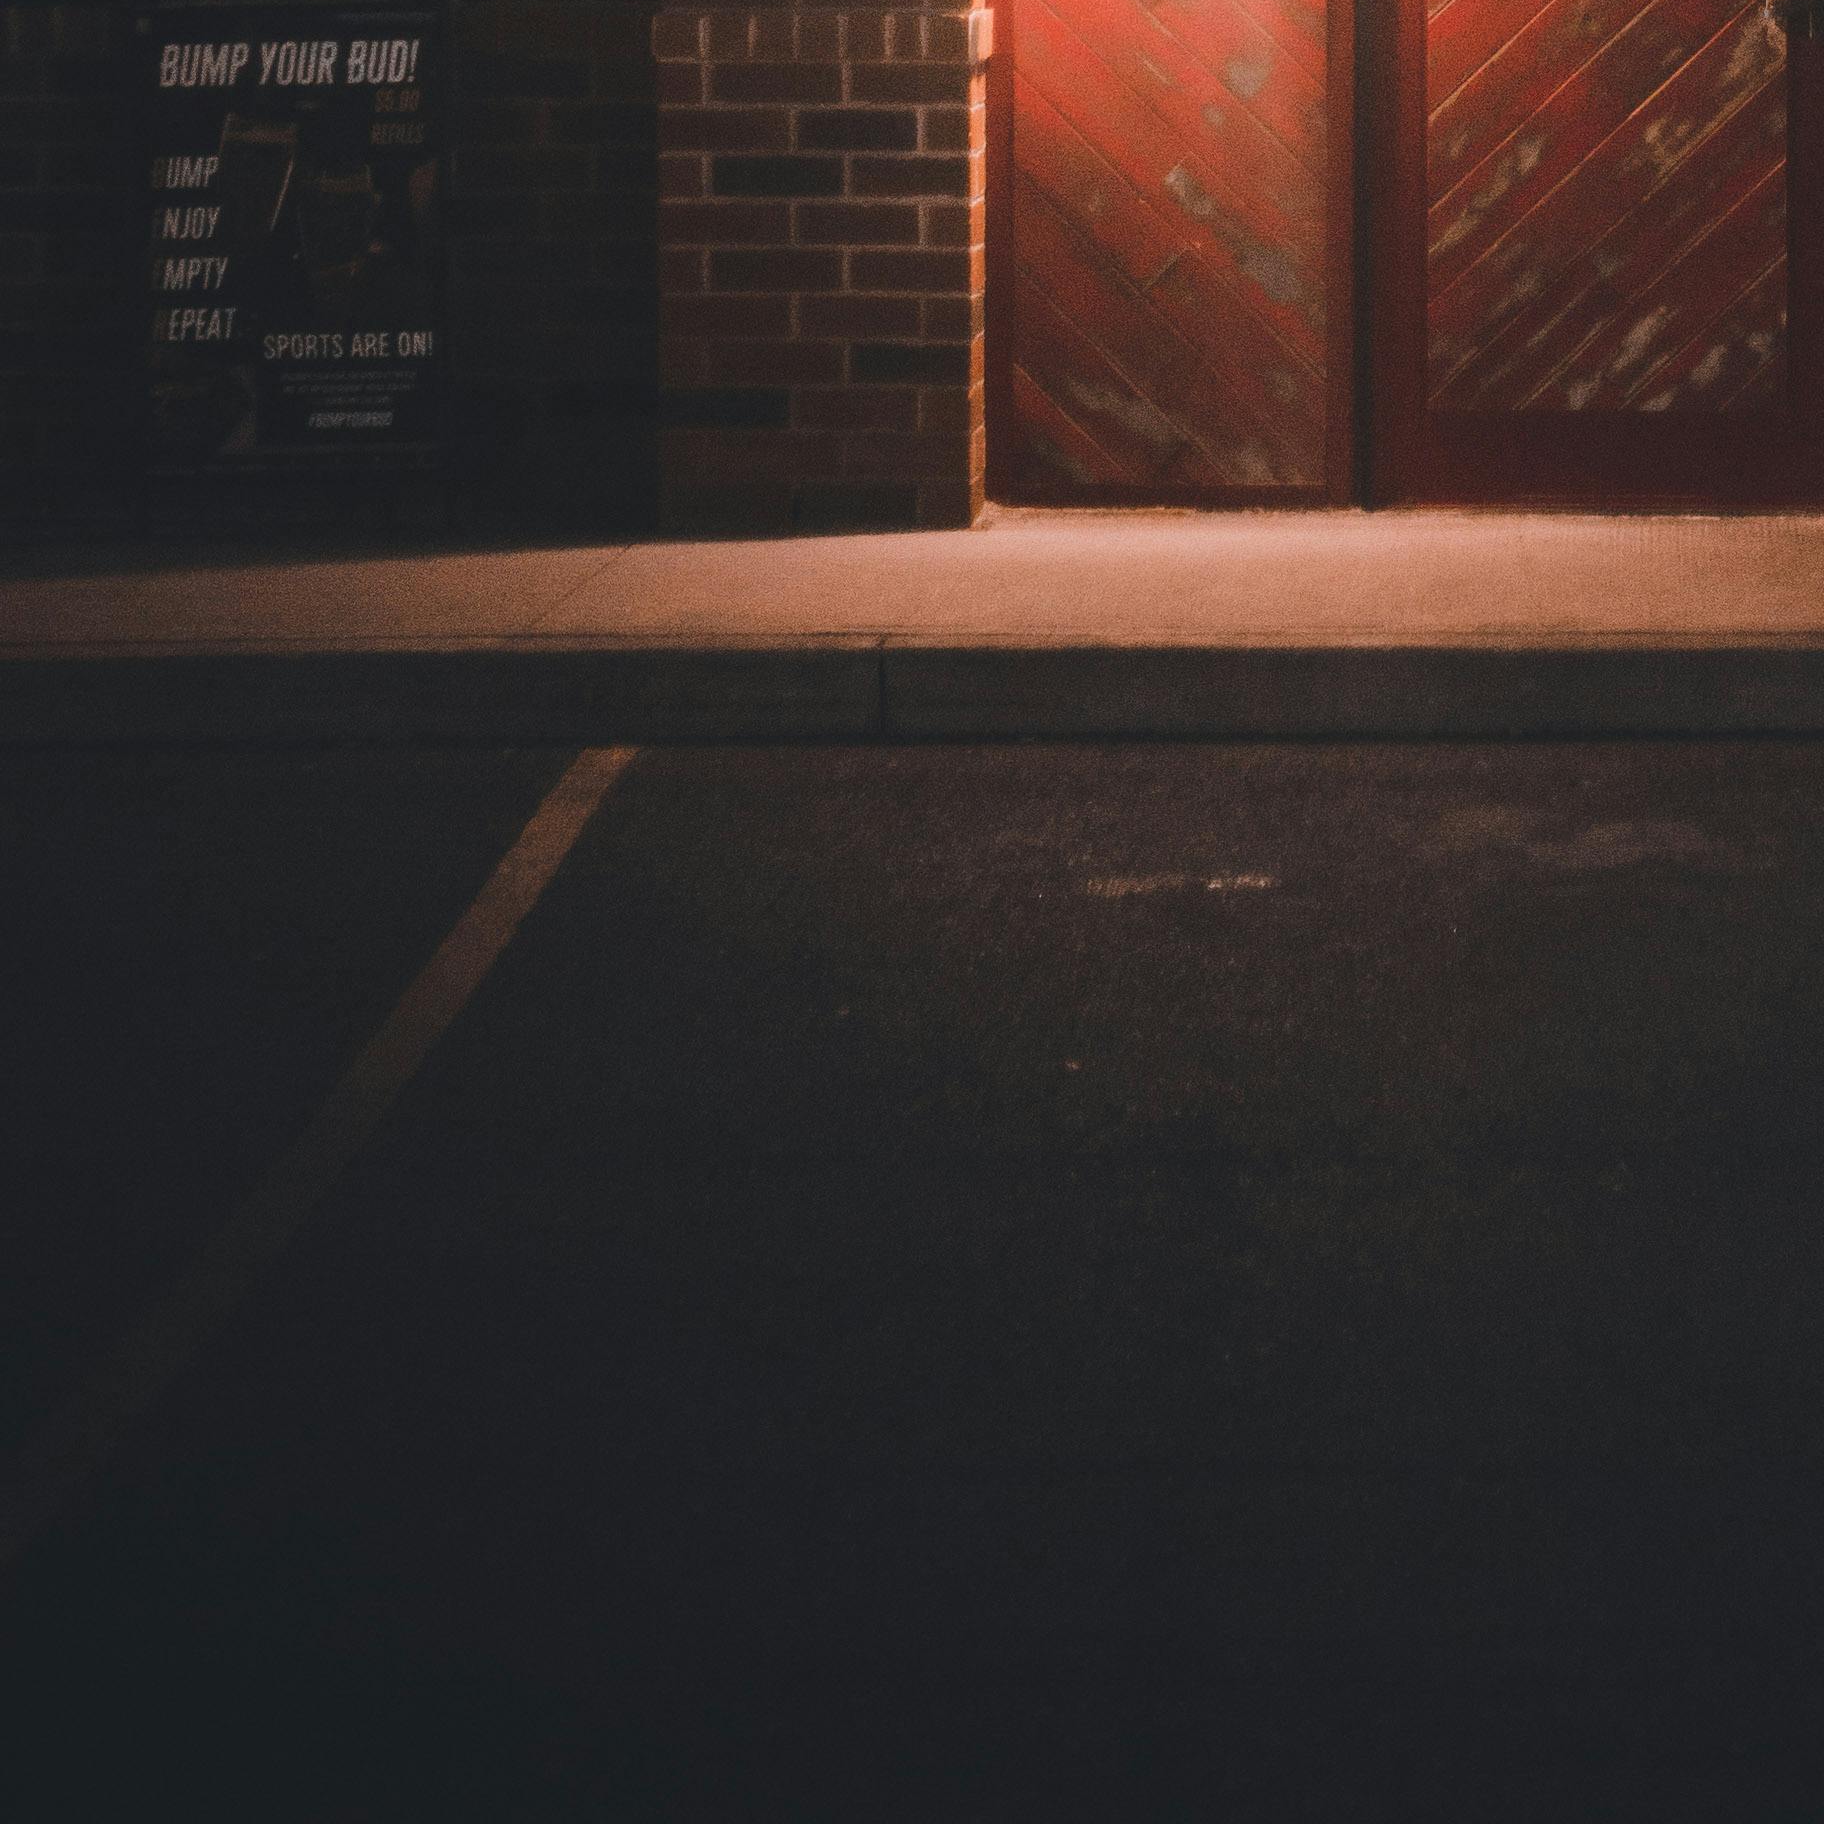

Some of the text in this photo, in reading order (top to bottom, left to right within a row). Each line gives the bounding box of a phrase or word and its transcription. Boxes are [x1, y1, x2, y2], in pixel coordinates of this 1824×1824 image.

[159, 38, 420, 89] BUMP YOUR BUD!
[263, 330, 434, 361] SPORTS ARE ON!
